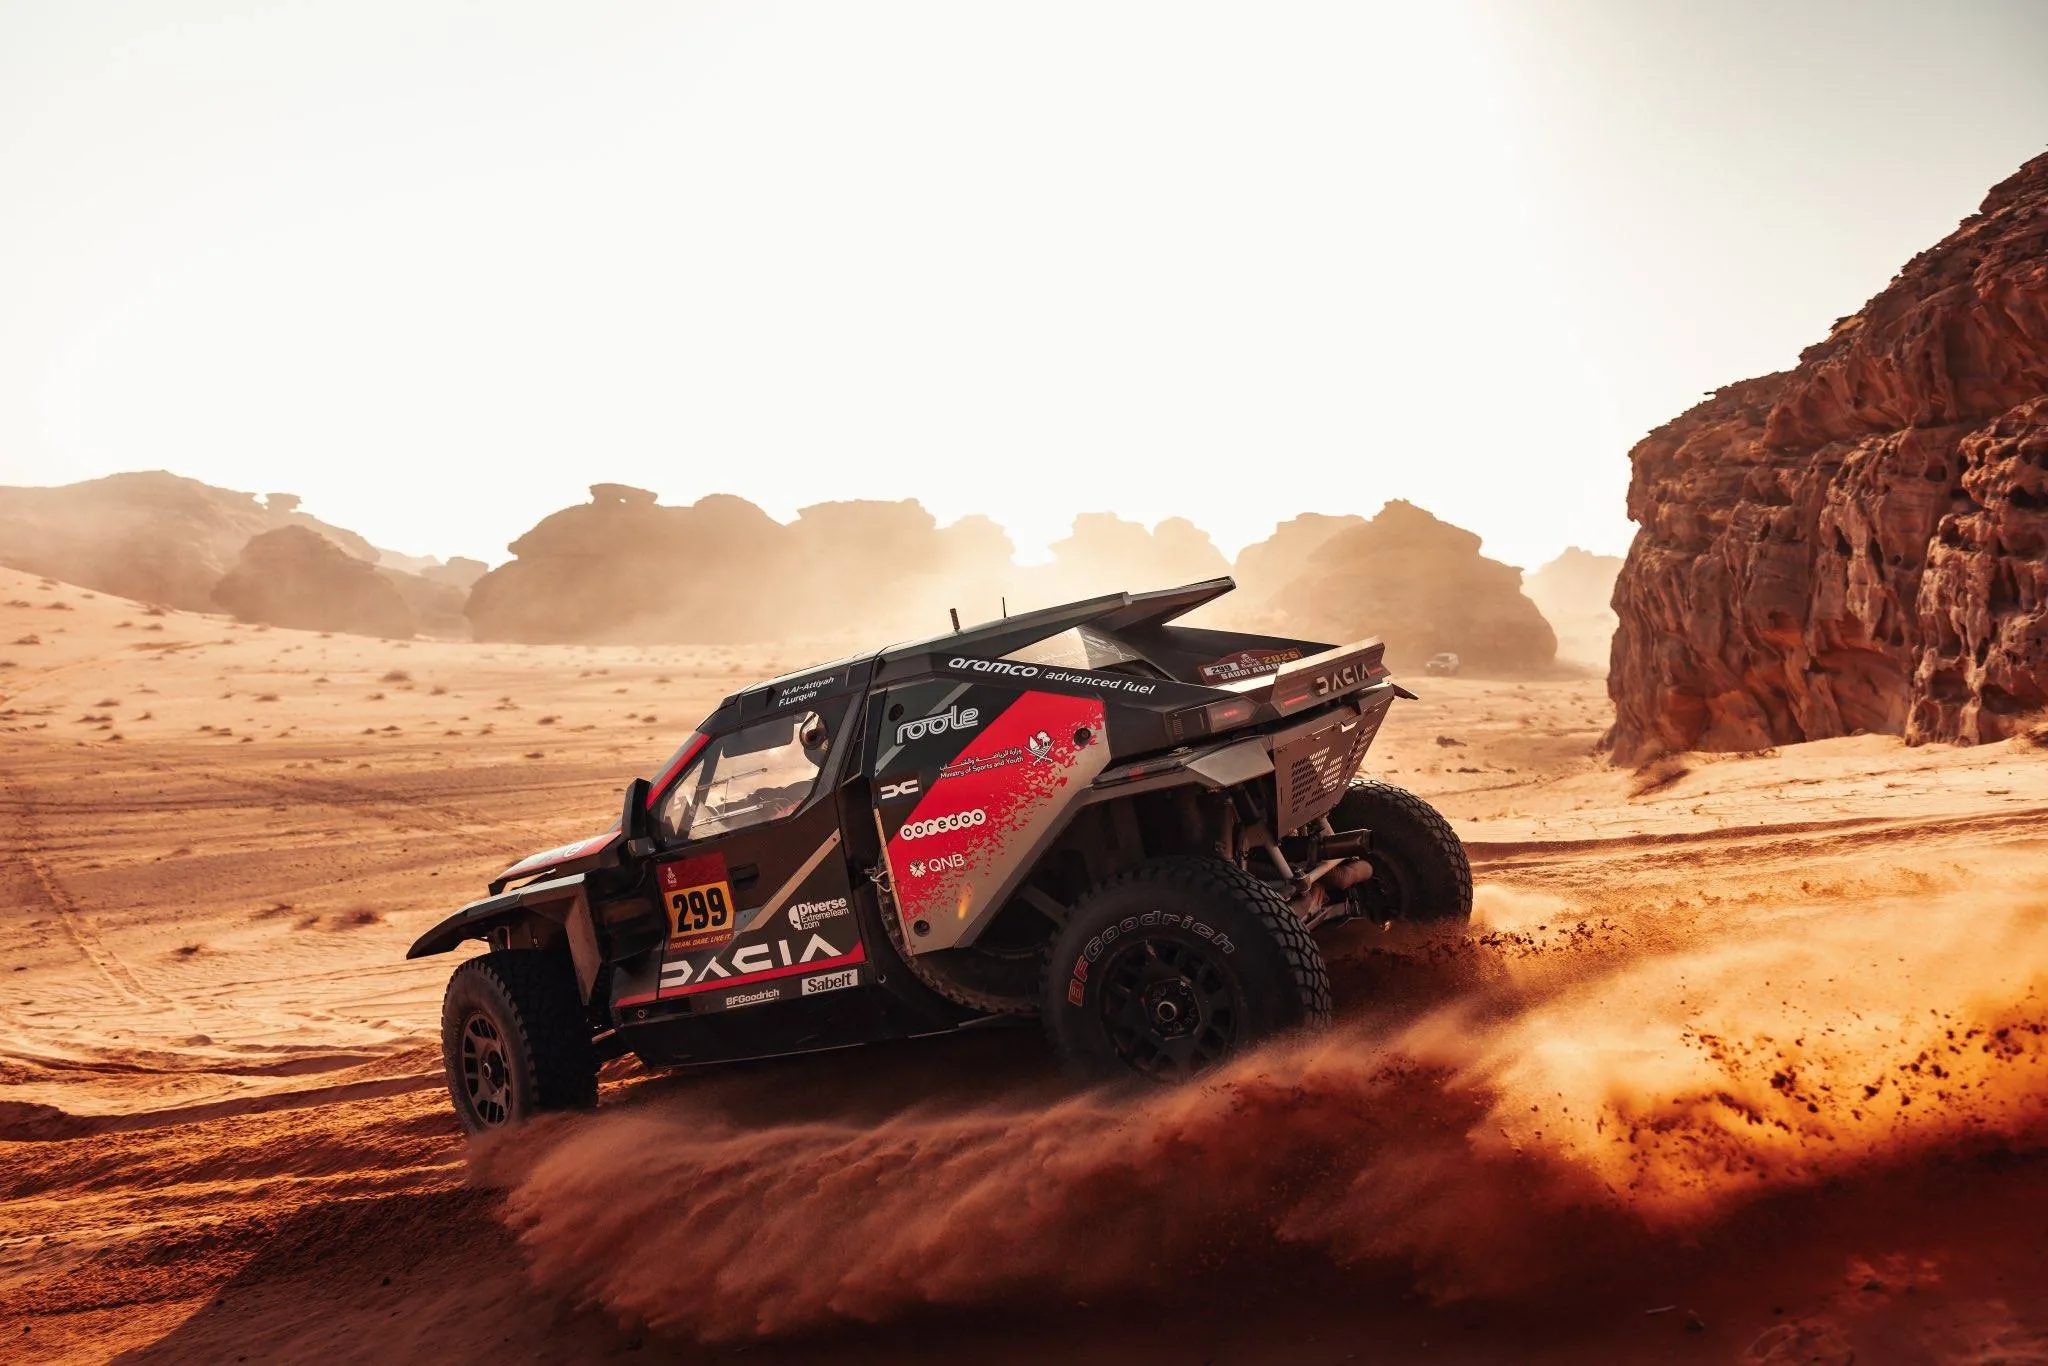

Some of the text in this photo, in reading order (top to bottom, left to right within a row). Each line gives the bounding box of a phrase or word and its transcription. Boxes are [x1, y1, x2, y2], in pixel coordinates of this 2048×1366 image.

[1262, 651, 1299, 665] 2026
[948, 657, 1156, 696] aramco advanced fuel
[1210, 664, 1232, 675] 299
[1220, 668, 1251, 680] SAUDI
[1252, 660, 1286, 675] ARAB
[1316, 663, 1371, 695] DACIA
[778, 691, 817, 707] F.Lurquin
[896, 705, 979, 745] roole
[940, 769, 964, 779] Ministry
[972, 762, 993, 773] Sports
[993, 760, 1005, 768] and
[1005, 756, 1024, 765] Youth
[901, 809, 985, 840] ooredoo
[928, 853, 965, 873] QNB
[672, 887, 728, 933] 299
[799, 897, 847, 914] Diverse
[801, 906, 850, 923] ExtremeTeam
[802, 920, 820, 930] .com
[659, 933, 843, 989] DACIA
[807, 971, 853, 993] Sabelt
[726, 988, 780, 1006] BFGoodrich
